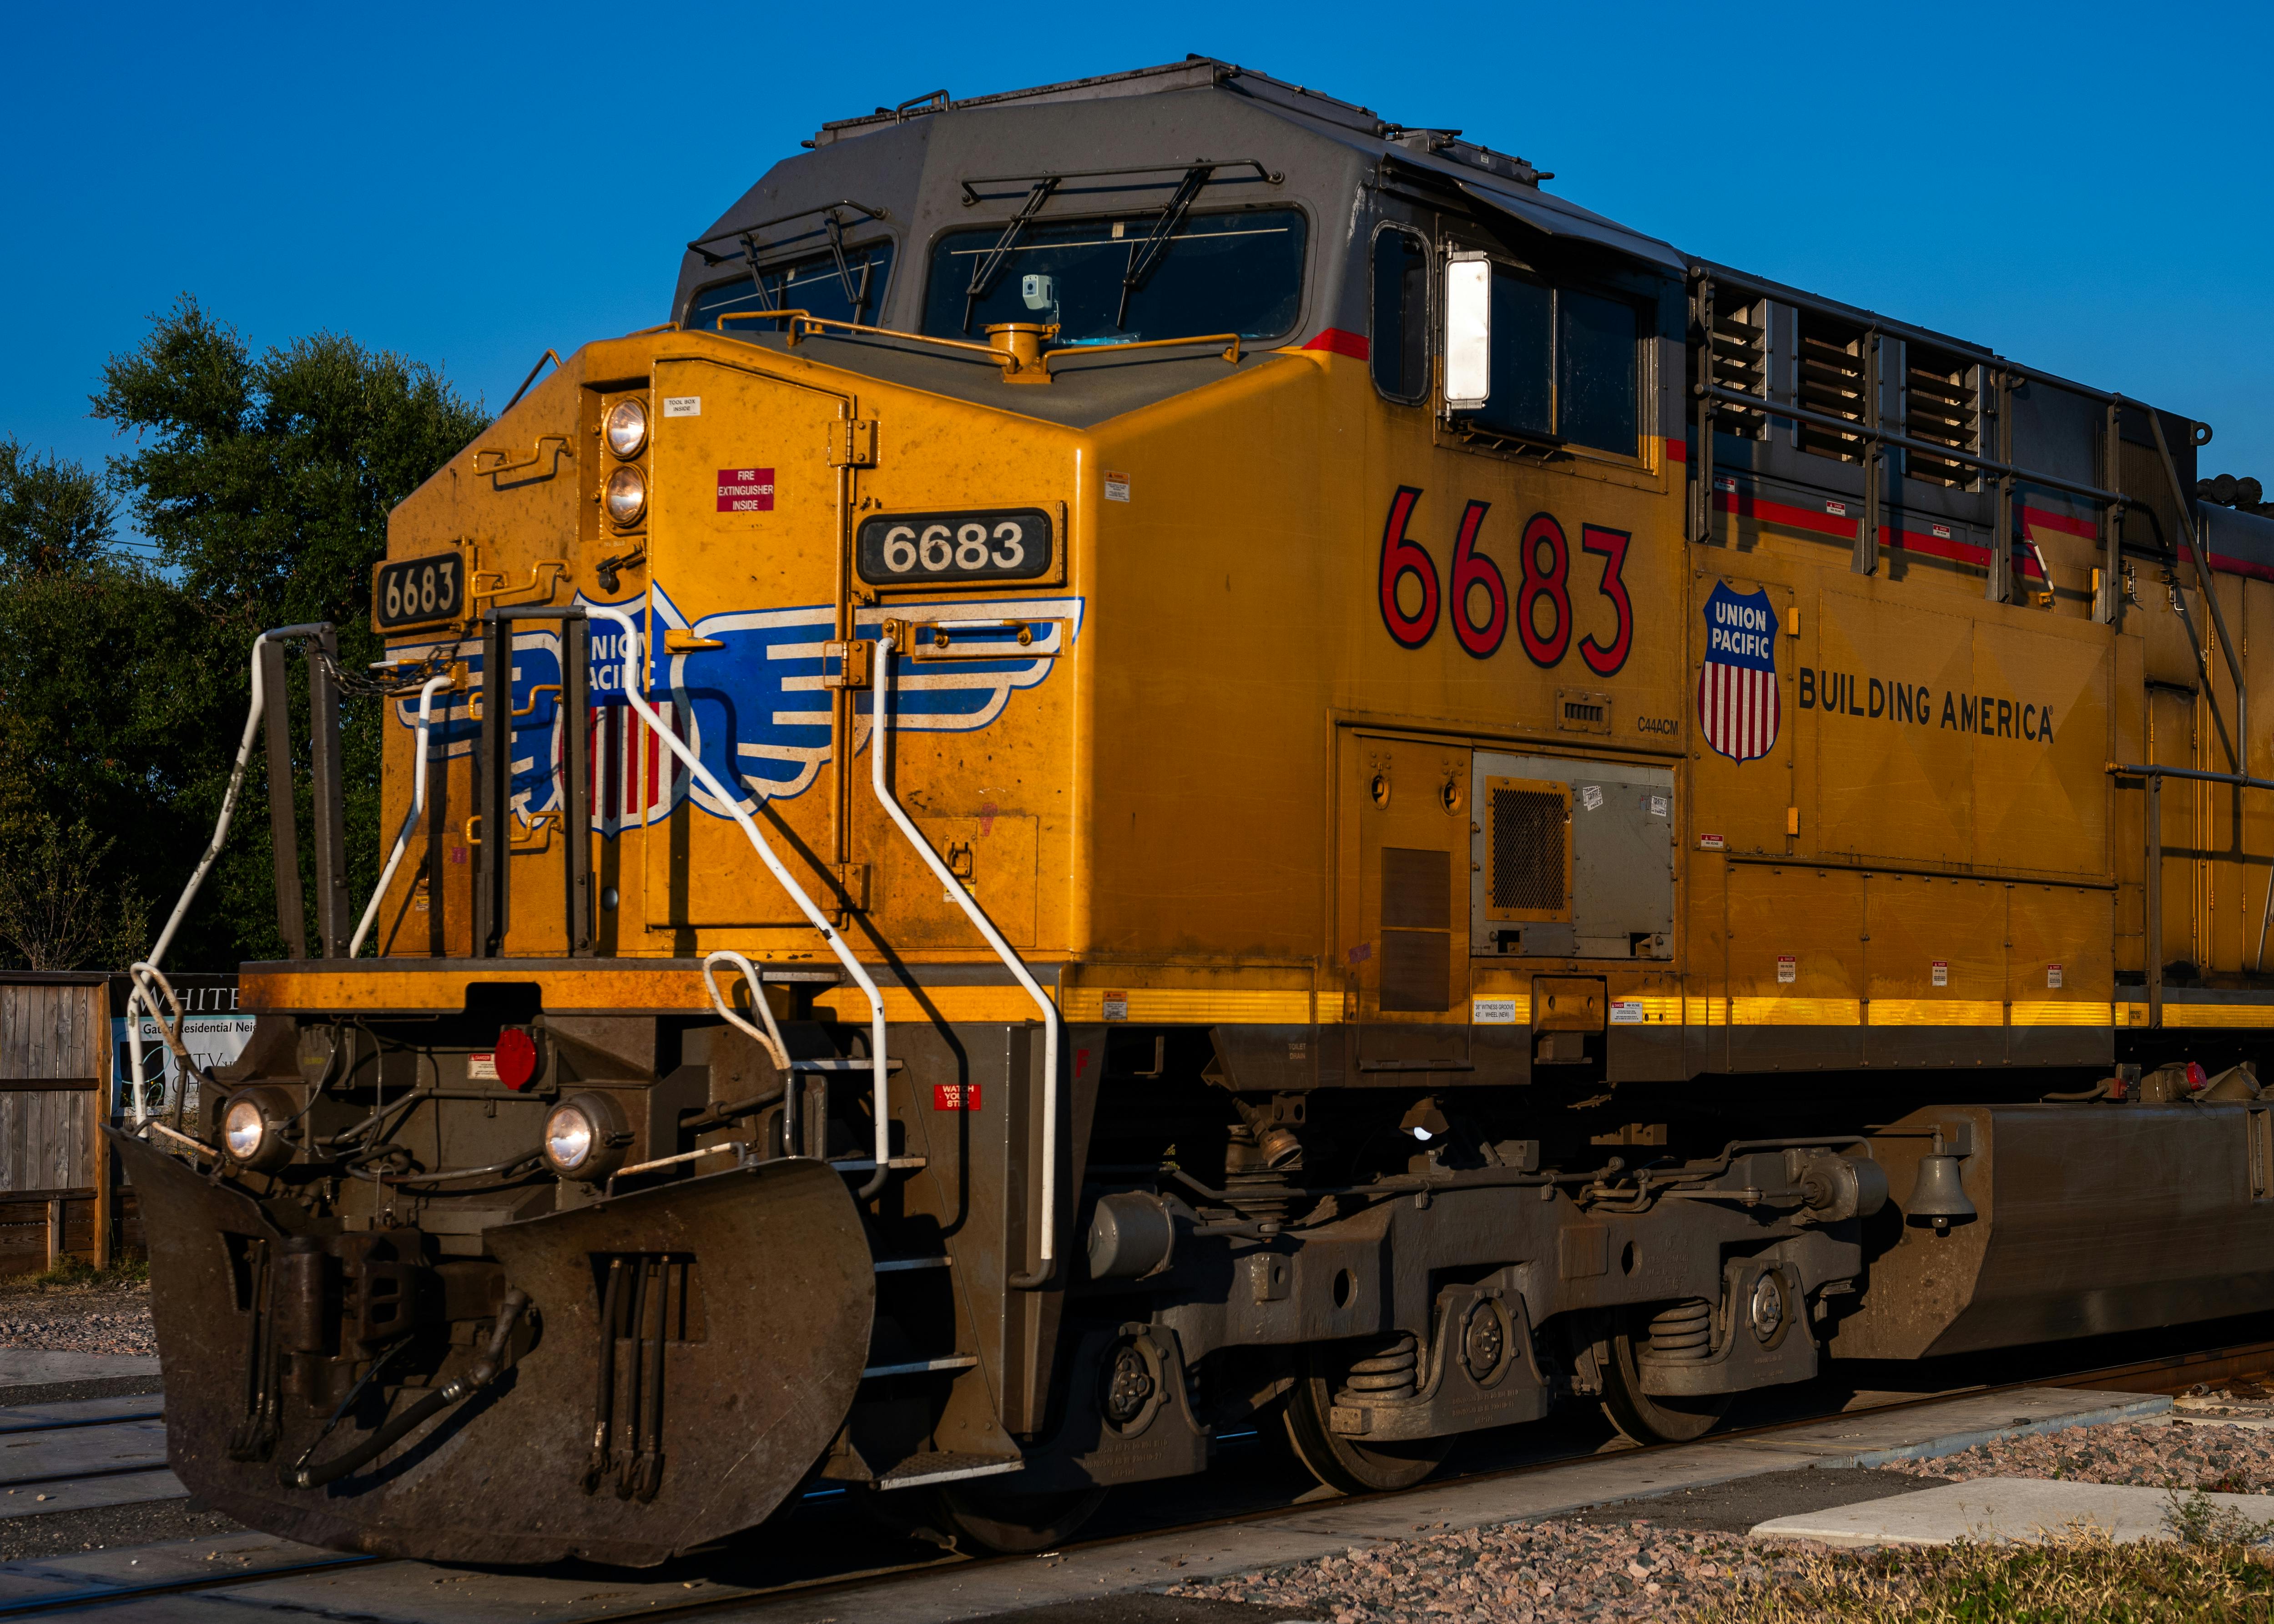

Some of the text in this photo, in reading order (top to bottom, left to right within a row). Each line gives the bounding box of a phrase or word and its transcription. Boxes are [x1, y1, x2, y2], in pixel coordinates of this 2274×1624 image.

[718, 484, 774, 496] EXTINGUISHER
[737, 471, 755, 480] FIRE
[732, 500, 758, 510] INSIDE
[883, 522, 1024, 572] 6683
[386, 562, 454, 618] 6683
[1378, 485, 1634, 678] 6683
[1716, 601, 1766, 632] UNION
[1712, 628, 1769, 659] PACIFIC
[1799, 667, 1930, 725] BUILDING
[1638, 716, 1678, 735] C44ACM
